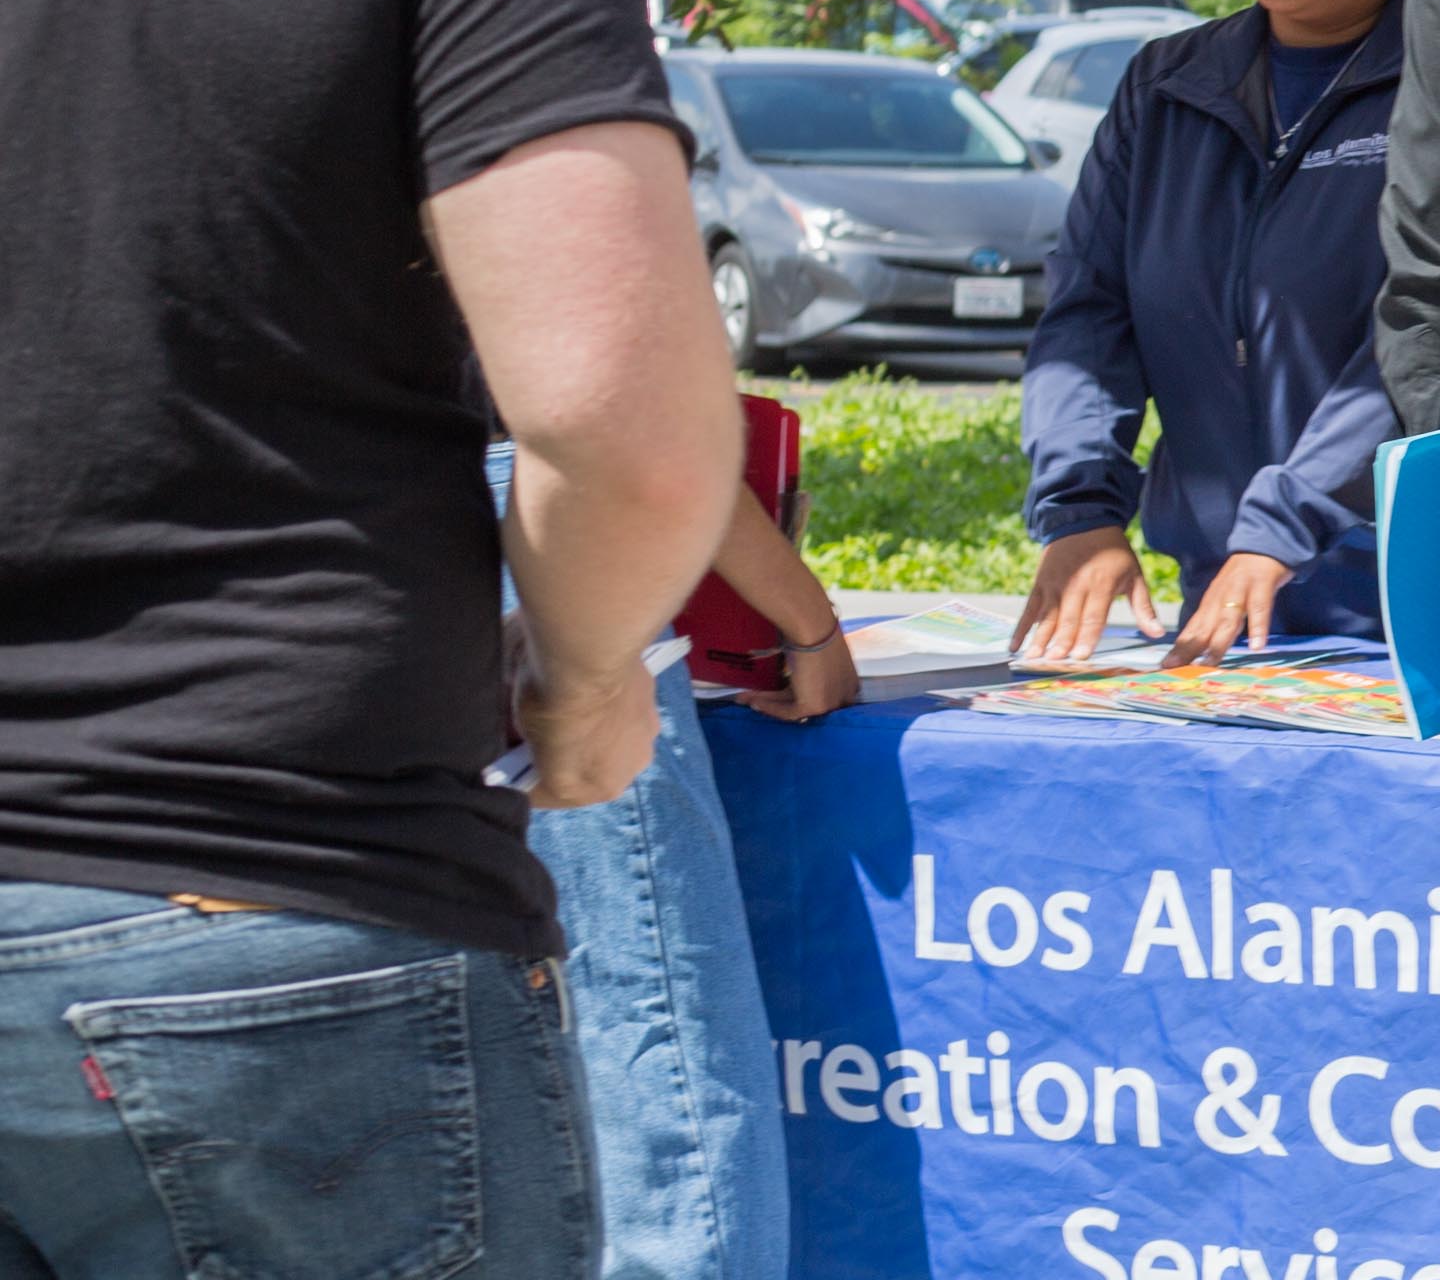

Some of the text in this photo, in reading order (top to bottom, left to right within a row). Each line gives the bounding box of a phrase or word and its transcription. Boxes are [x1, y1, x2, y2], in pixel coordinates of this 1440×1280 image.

[913, 853, 1092, 970] Los
[772, 1031, 1162, 1149] reation
[1194, 1047, 1289, 1157] &
